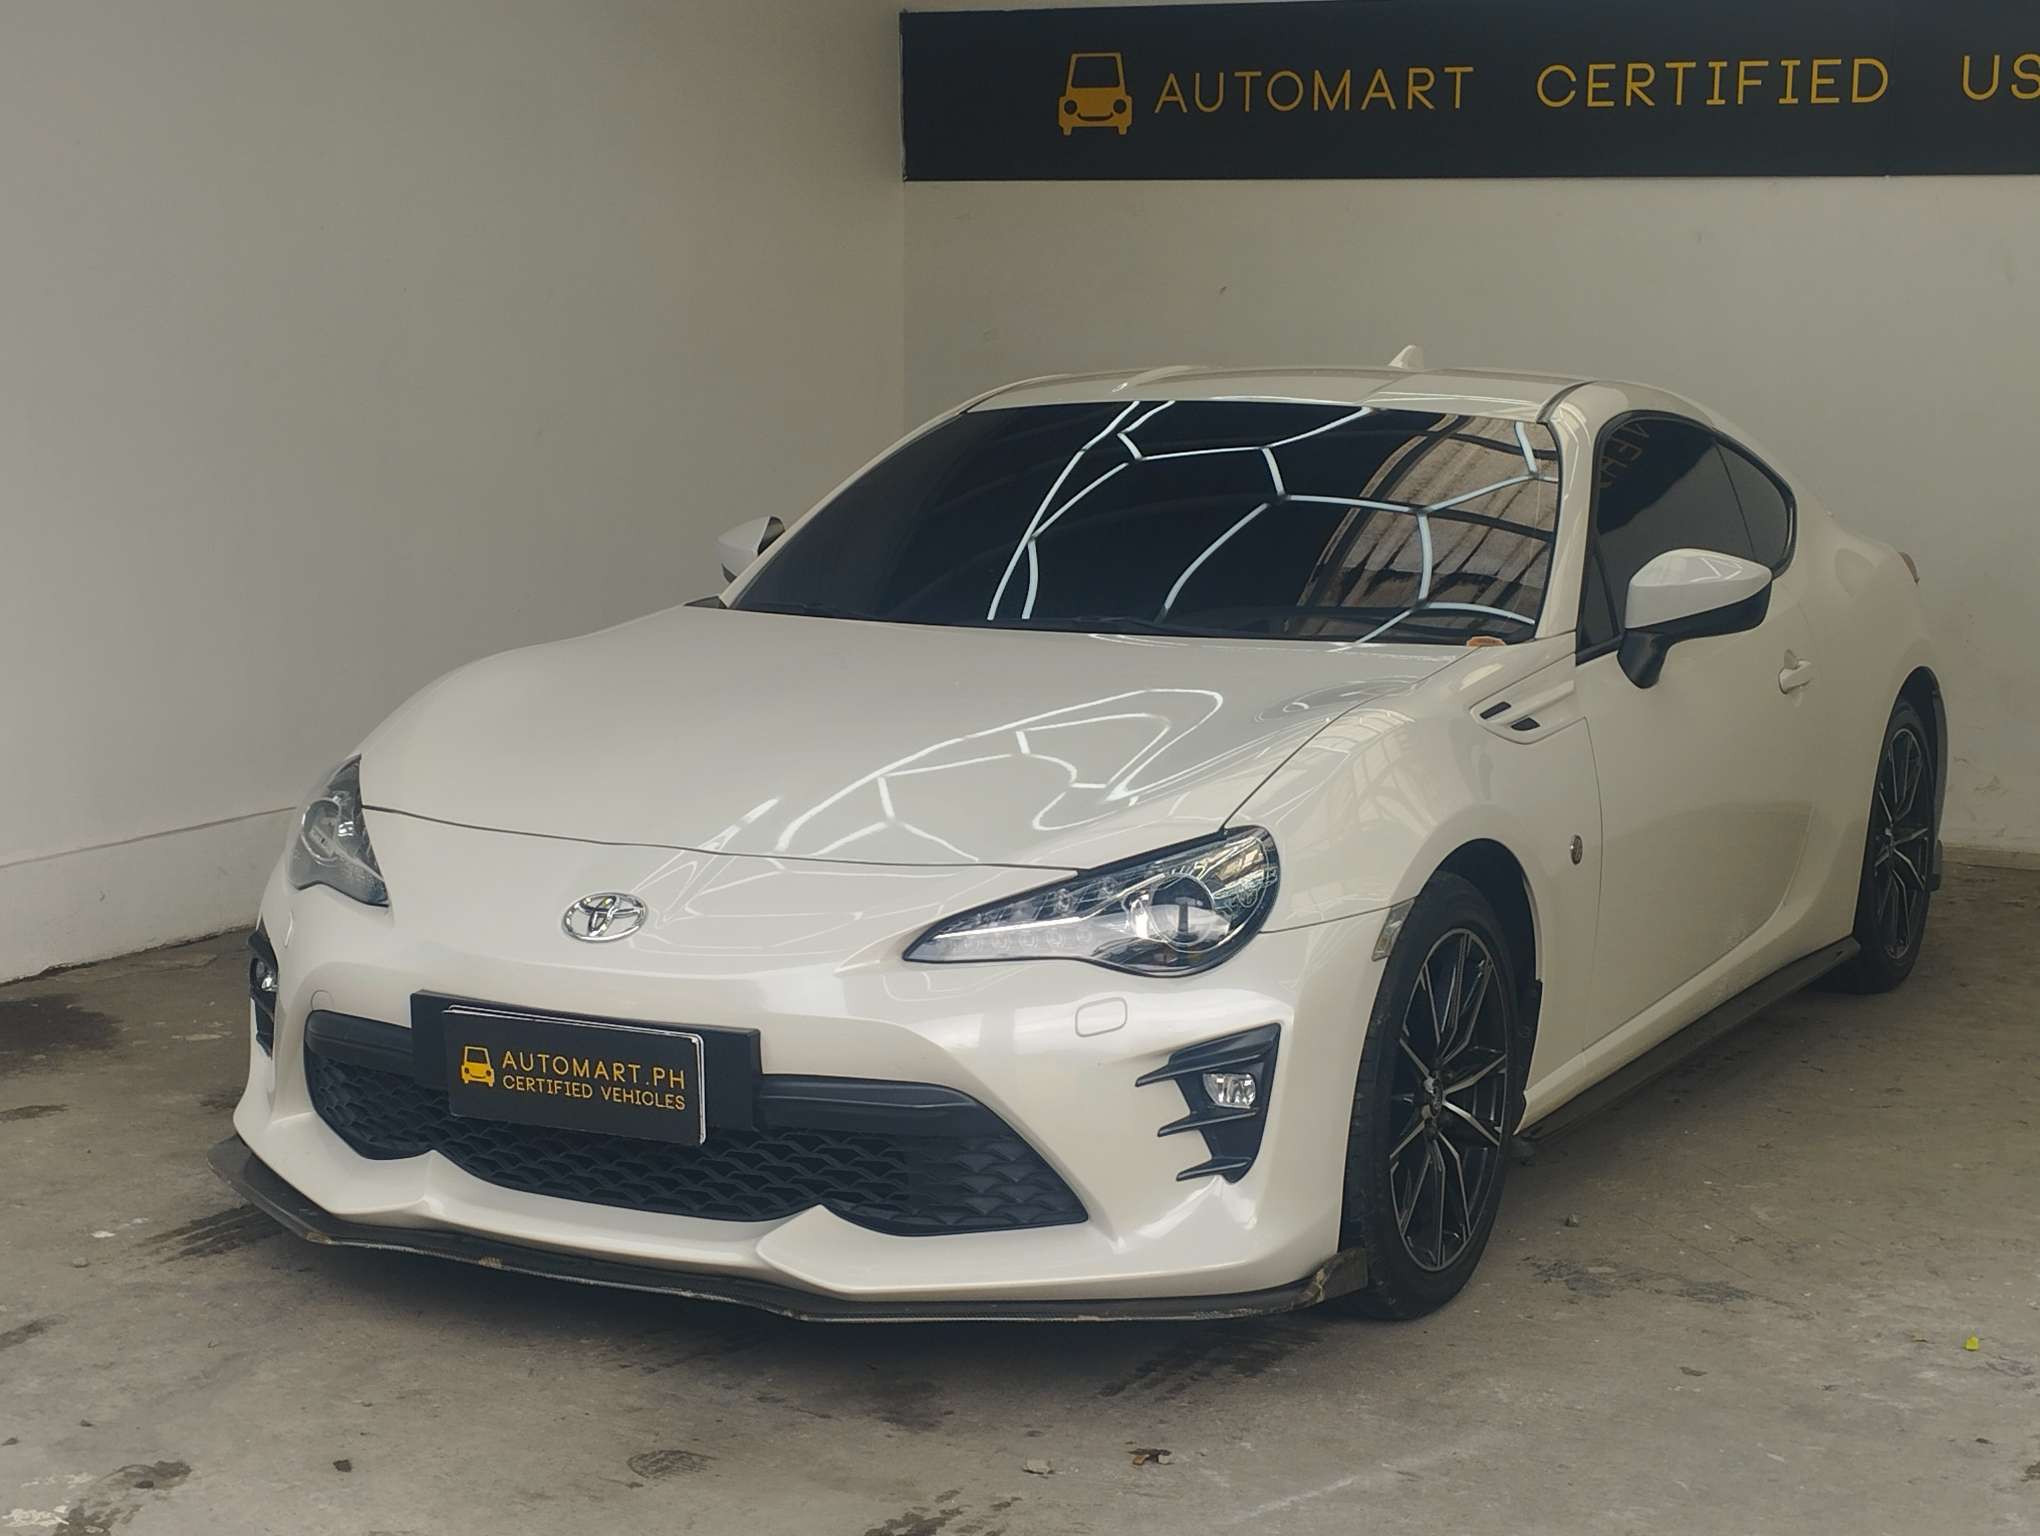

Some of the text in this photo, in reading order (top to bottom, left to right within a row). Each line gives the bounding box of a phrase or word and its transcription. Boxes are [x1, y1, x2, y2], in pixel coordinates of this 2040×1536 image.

[1154, 67, 1474, 113] AUTOMART
[1535, 58, 1890, 108] CERTIFIED
[502, 1050, 685, 1090] AUTOMART.PH
[502, 1074, 686, 1111] CERTIFIED VEHICLES
